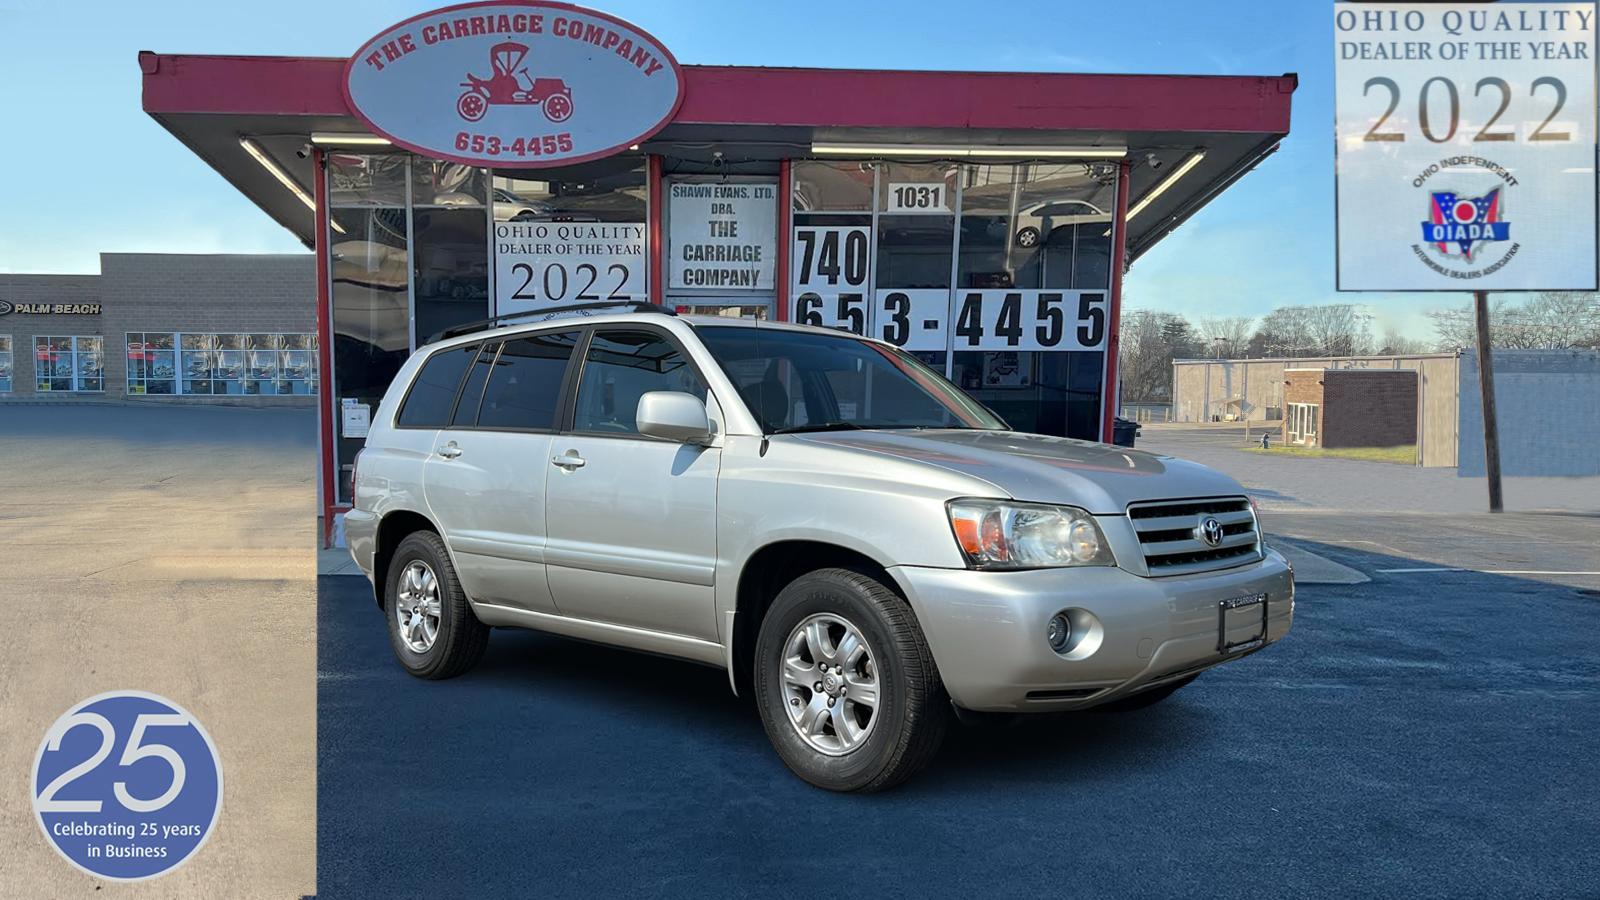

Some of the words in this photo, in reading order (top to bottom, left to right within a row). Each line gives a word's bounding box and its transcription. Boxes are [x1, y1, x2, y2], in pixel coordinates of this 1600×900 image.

[1336, 10, 1425, 31] OHIO
[1442, 10, 1592, 35] QUALITY
[366, 33, 416, 72] THE
[422, 14, 543, 45] CARRIAGE
[553, 17, 663, 77] COMPANY
[1340, 42, 1433, 60] DEALER
[1438, 42, 1469, 60] OF
[1475, 42, 1521, 60] THE
[1528, 42, 1589, 60] YEAR
[1362, 76, 1571, 143] 2022
[454, 132, 573, 157] 653-4455
[1412, 163, 1440, 188] OHIO
[1440, 156, 1519, 187] INDEPENDENT
[673, 186, 711, 198] SHAWN
[754, 186, 774, 199] LTD.
[893, 186, 940, 208] 1031
[711, 203, 735, 216] DBA.
[497, 226, 548, 239] OHIO
[557, 226, 643, 241] QUALITY
[708, 220, 738, 238] THE
[1432, 224, 1496, 240] OIADA
[500, 244, 552, 255] DEALER
[555, 244, 573, 255] OF
[576, 244, 604, 255] THE
[607, 244, 641, 255] YEAR
[683, 245, 762, 262] CARRIAGE
[798, 230, 868, 285] 740
[511, 263, 631, 301] 2022
[683, 268, 760, 286] COMPANY
[15, 304, 51, 314] PALM
[55, 304, 100, 314] BEACH
